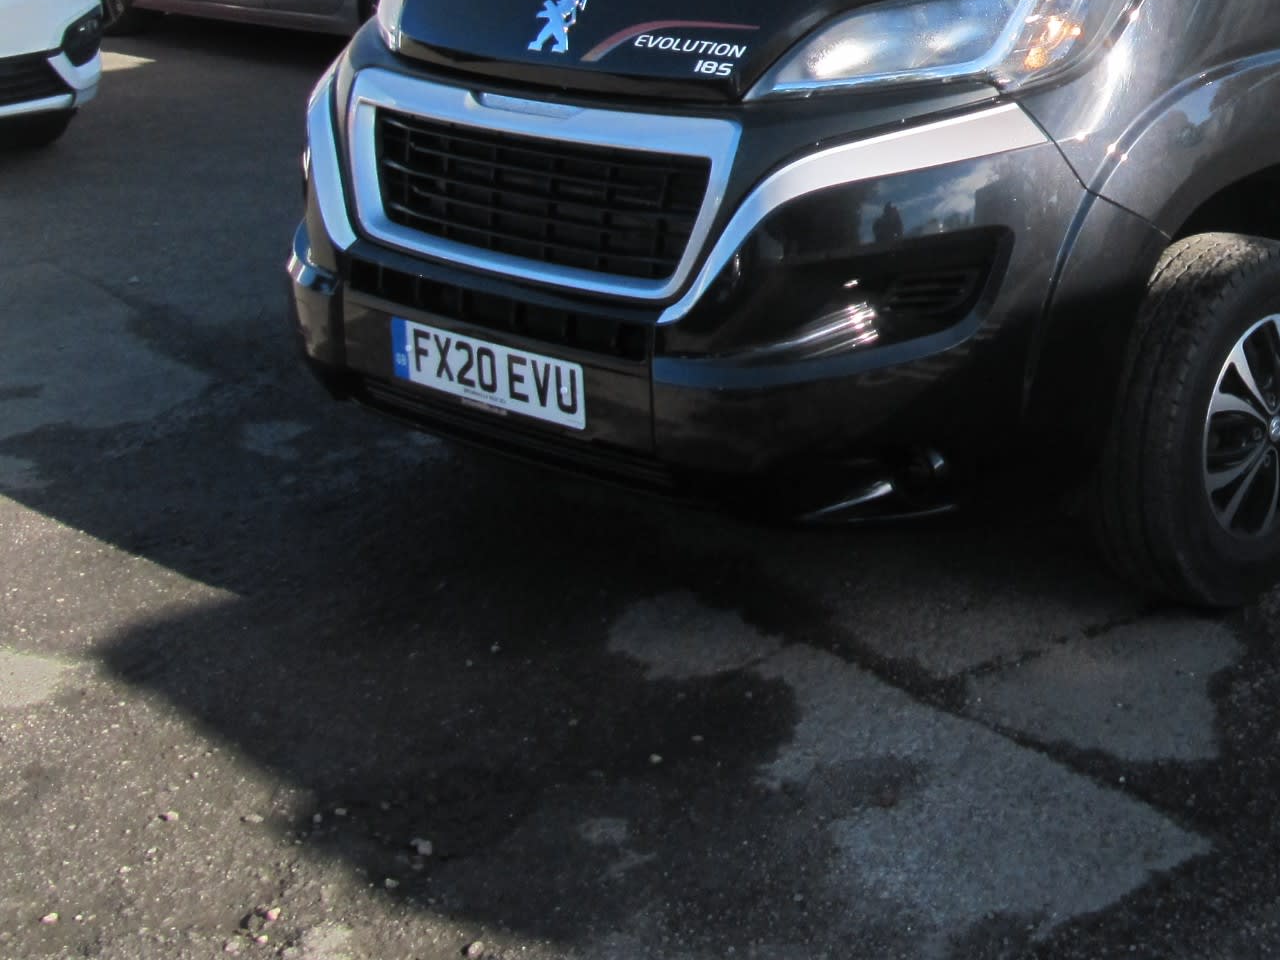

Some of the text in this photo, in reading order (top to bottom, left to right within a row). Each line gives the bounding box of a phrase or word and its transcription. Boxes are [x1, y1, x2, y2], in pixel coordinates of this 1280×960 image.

[634, 34, 747, 58] EVOLUTION
[694, 59, 734, 76] 185
[413, 328, 577, 415] FX20 EVU
